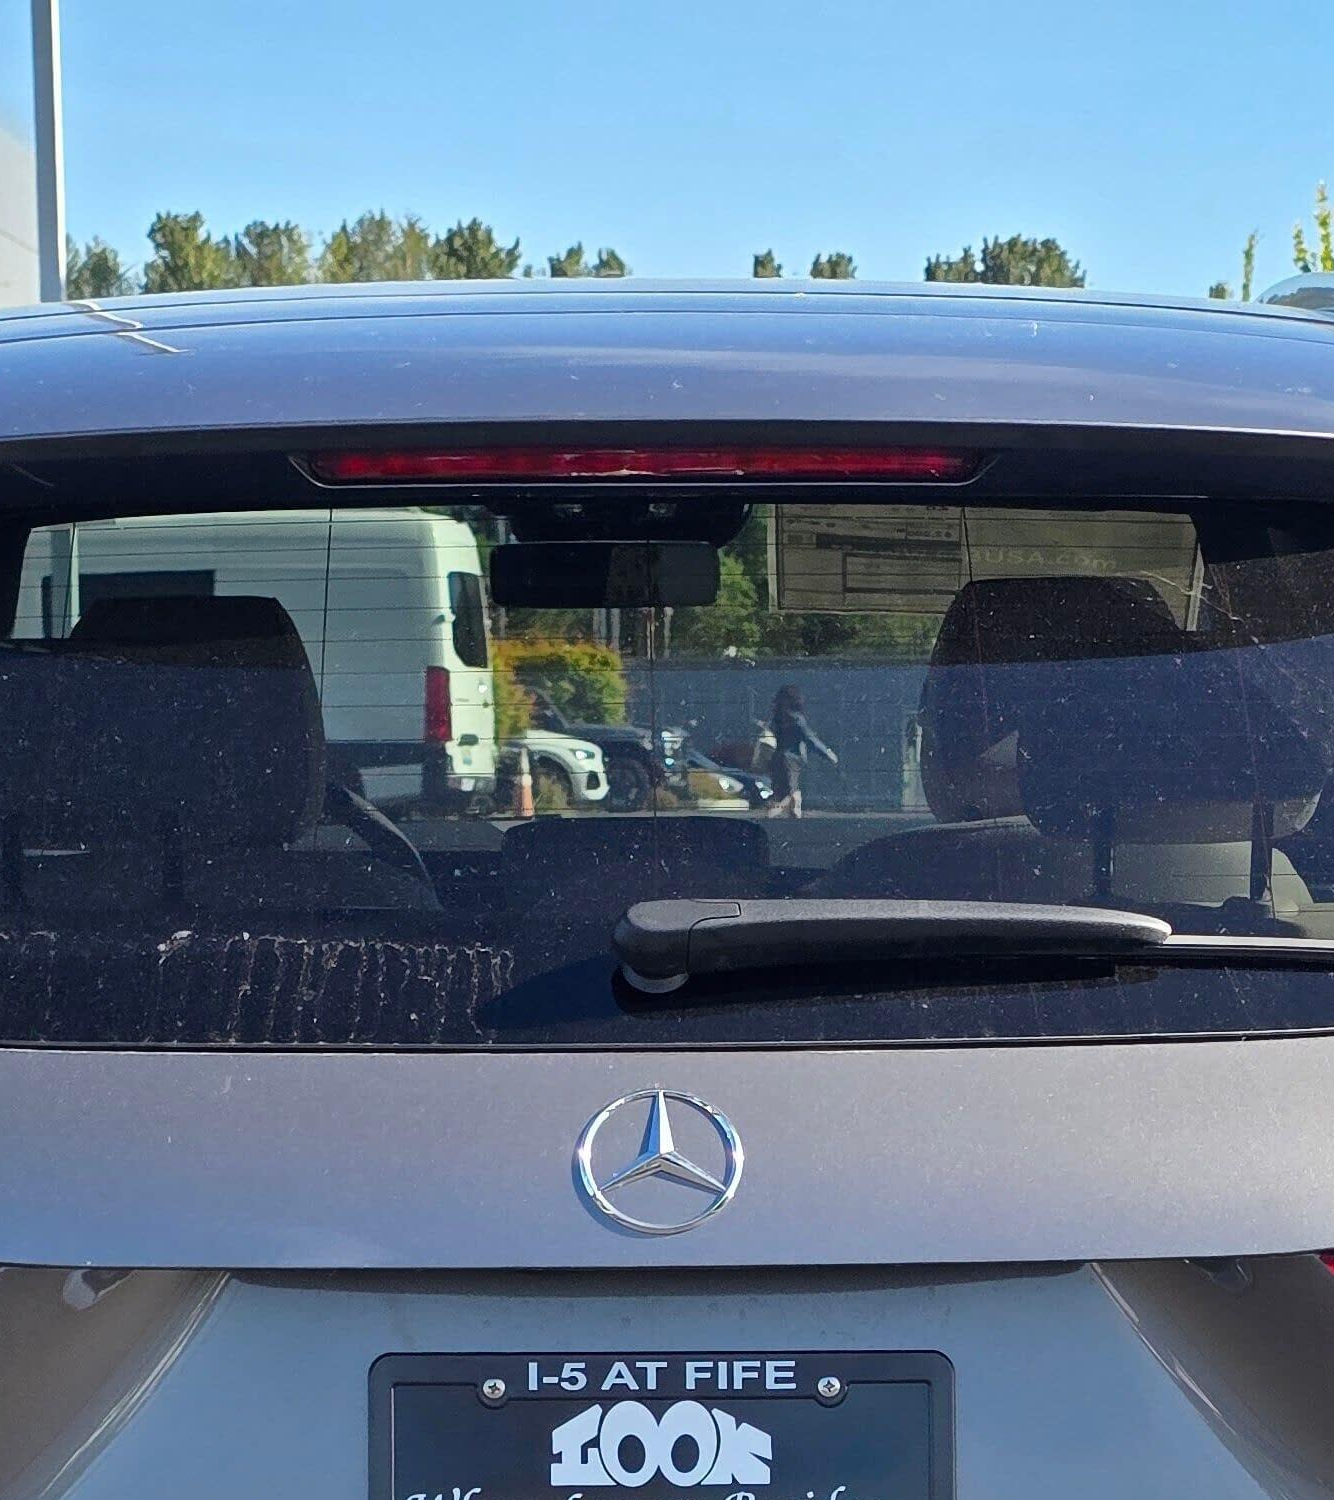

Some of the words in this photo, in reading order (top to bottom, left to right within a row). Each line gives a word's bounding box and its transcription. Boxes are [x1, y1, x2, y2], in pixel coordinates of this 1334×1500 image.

[528, 1361, 588, 1391] I-5
[600, 1361, 668, 1391] AT
[685, 1360, 797, 1390] FIFE
